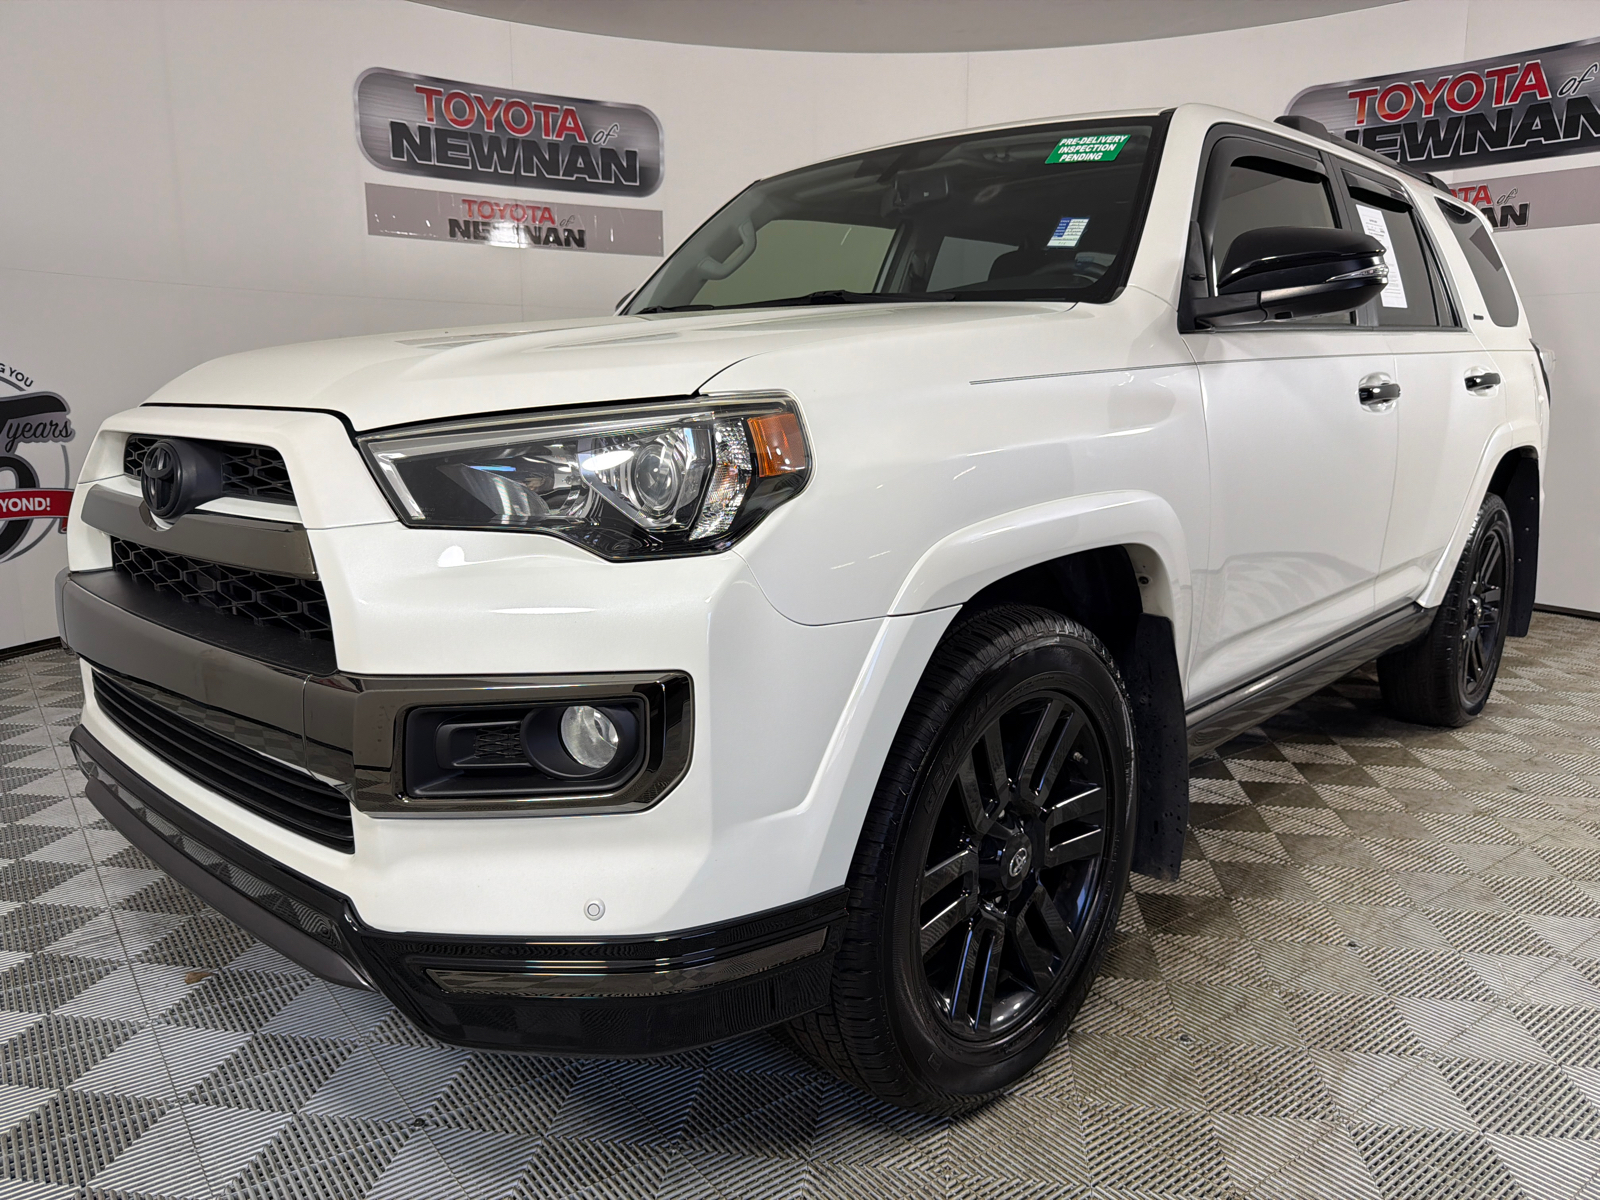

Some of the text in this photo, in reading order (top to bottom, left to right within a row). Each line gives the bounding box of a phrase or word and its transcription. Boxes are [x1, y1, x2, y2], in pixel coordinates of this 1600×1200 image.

[1348, 59, 1599, 126] TOYOTA of
[414, 84, 619, 145] TOYOTA of
[389, 120, 640, 186] NEWNAN
[1058, 144, 1117, 154] INSPECTION
[1059, 135, 1128, 146] PRE-DELIVERY
[1059, 152, 1104, 162] PENDING
[1497, 187, 1518, 205] of
[461, 198, 576, 227] TOYOTA of
[9, 366, 34, 387] YOU
[5, 420, 72, 453] years
